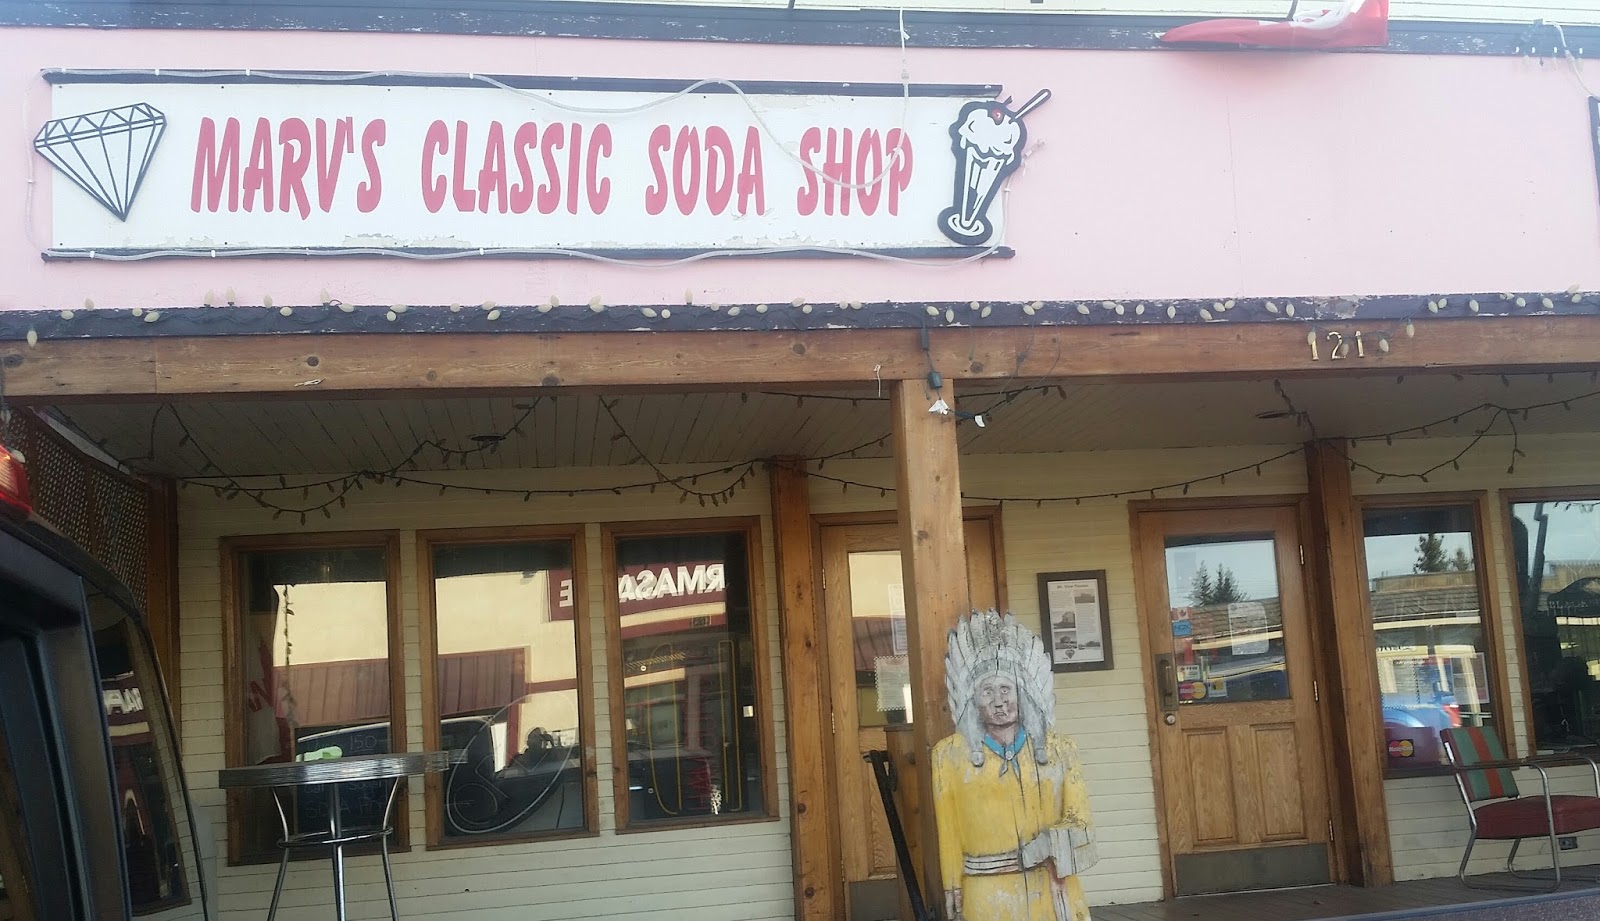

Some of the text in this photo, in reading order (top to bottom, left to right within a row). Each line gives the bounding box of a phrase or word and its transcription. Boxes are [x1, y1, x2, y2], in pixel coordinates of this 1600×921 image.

[191, 117, 913, 220] MARV'S CLASSIC SODA SHOP
[1308, 330, 1365, 361] 121
